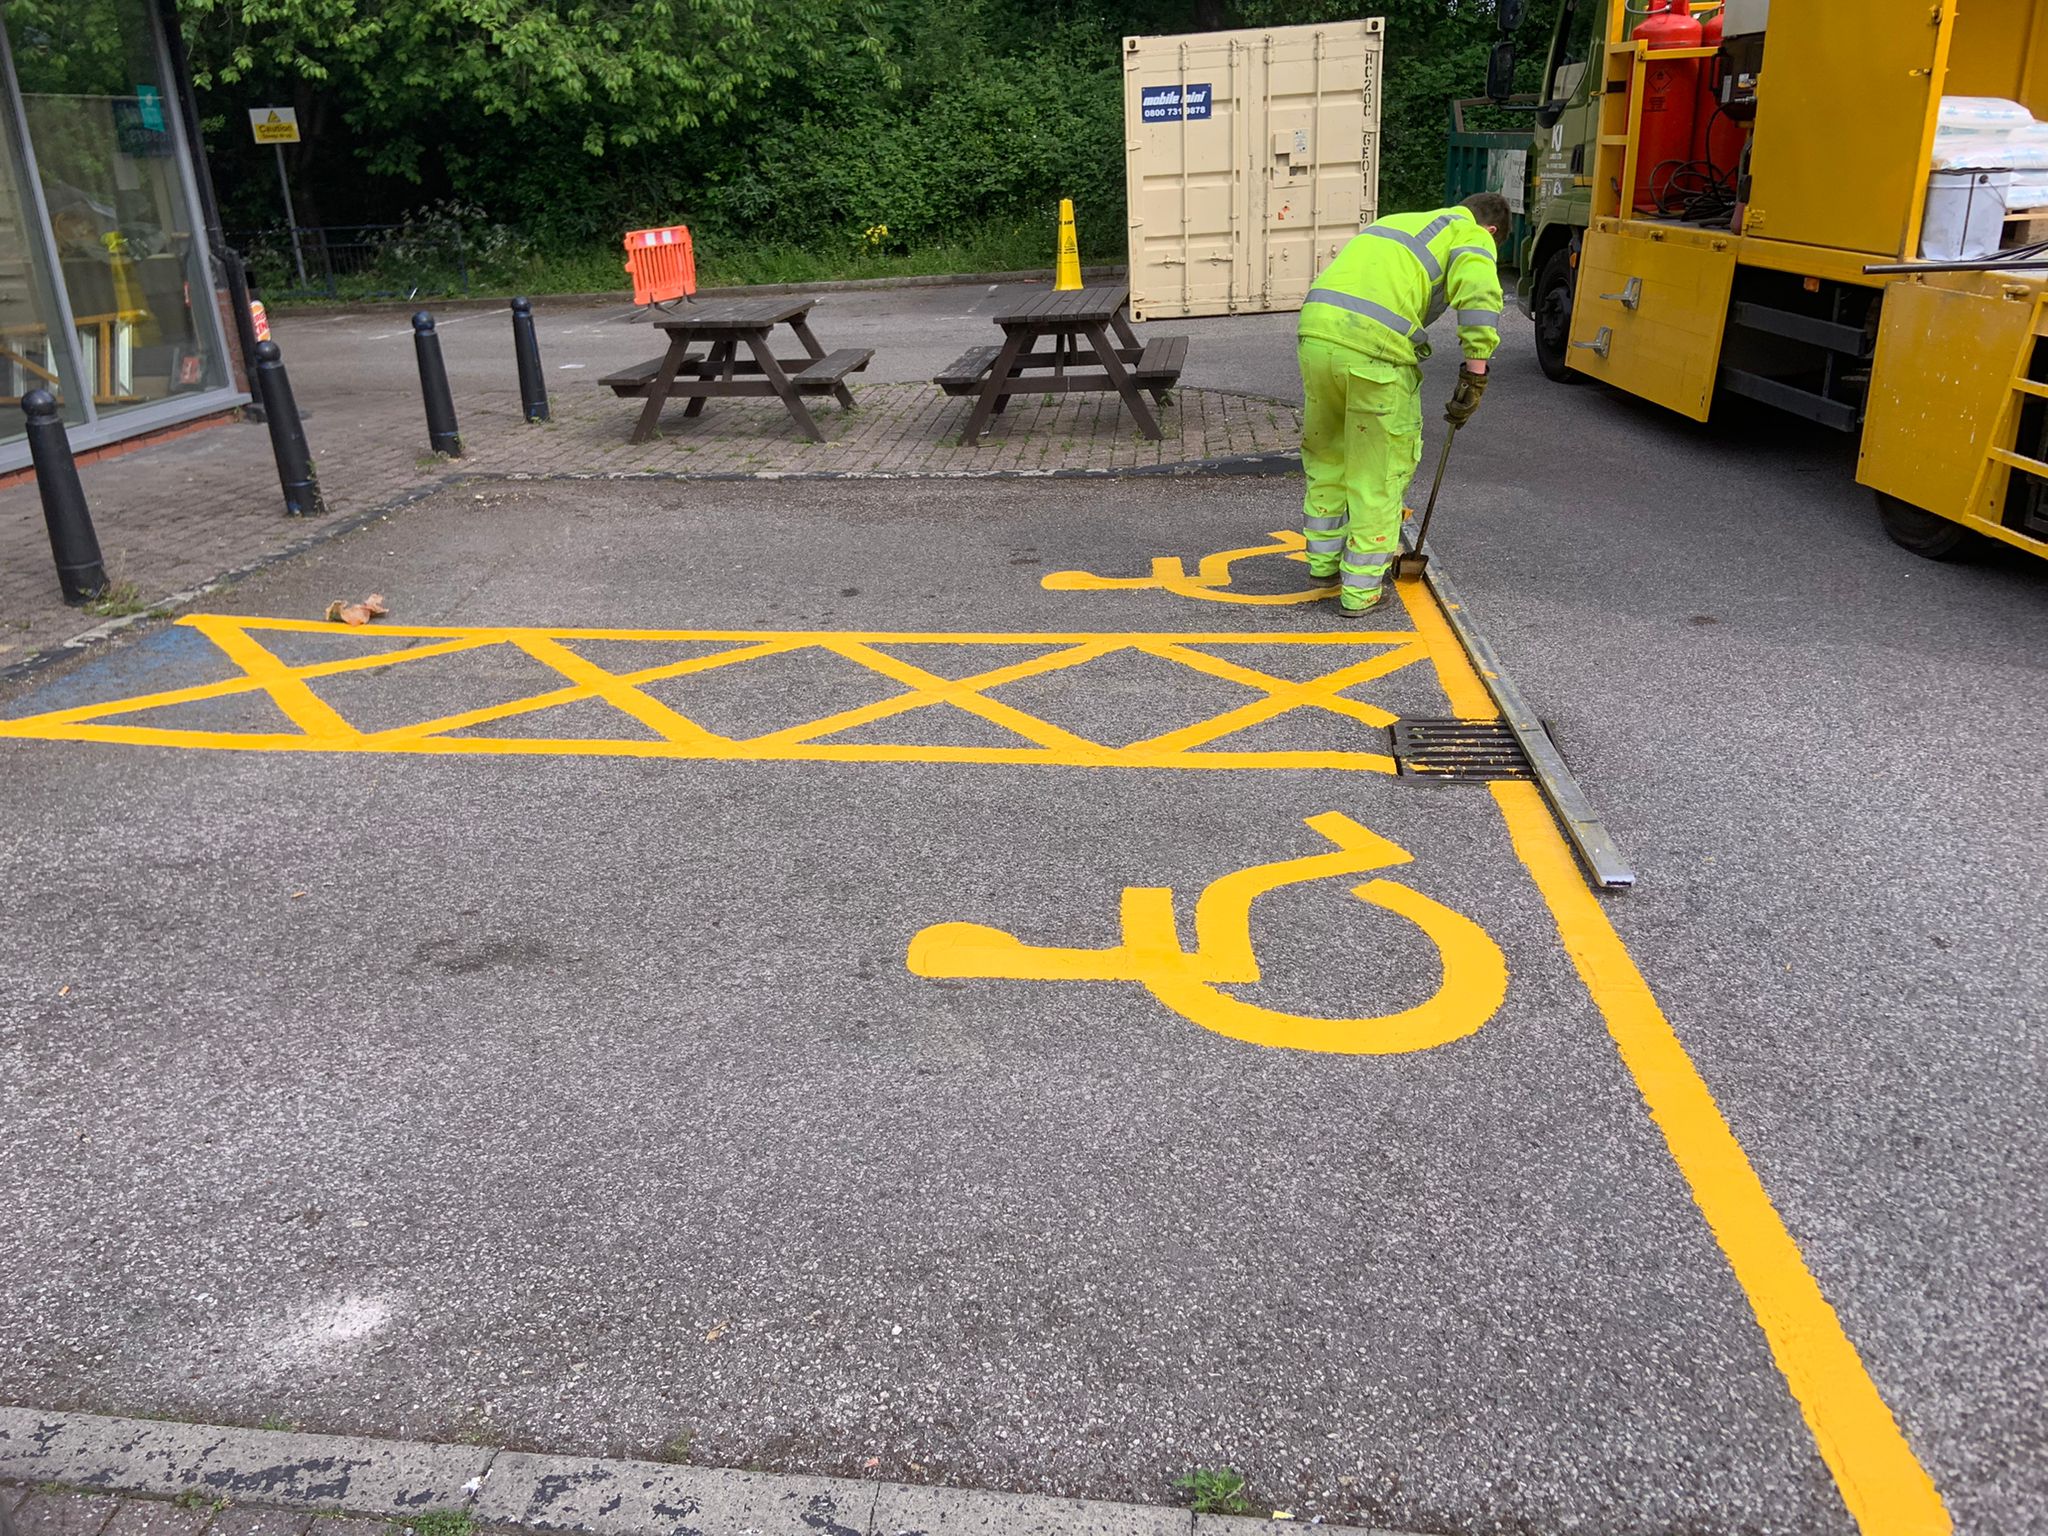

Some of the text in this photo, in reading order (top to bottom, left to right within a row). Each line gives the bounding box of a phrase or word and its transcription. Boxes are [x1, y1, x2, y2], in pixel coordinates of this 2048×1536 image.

[1143, 91, 1180, 106] mobile
[1144, 108, 1165, 117] 0800
[1167, 107, 1182, 116] 731
